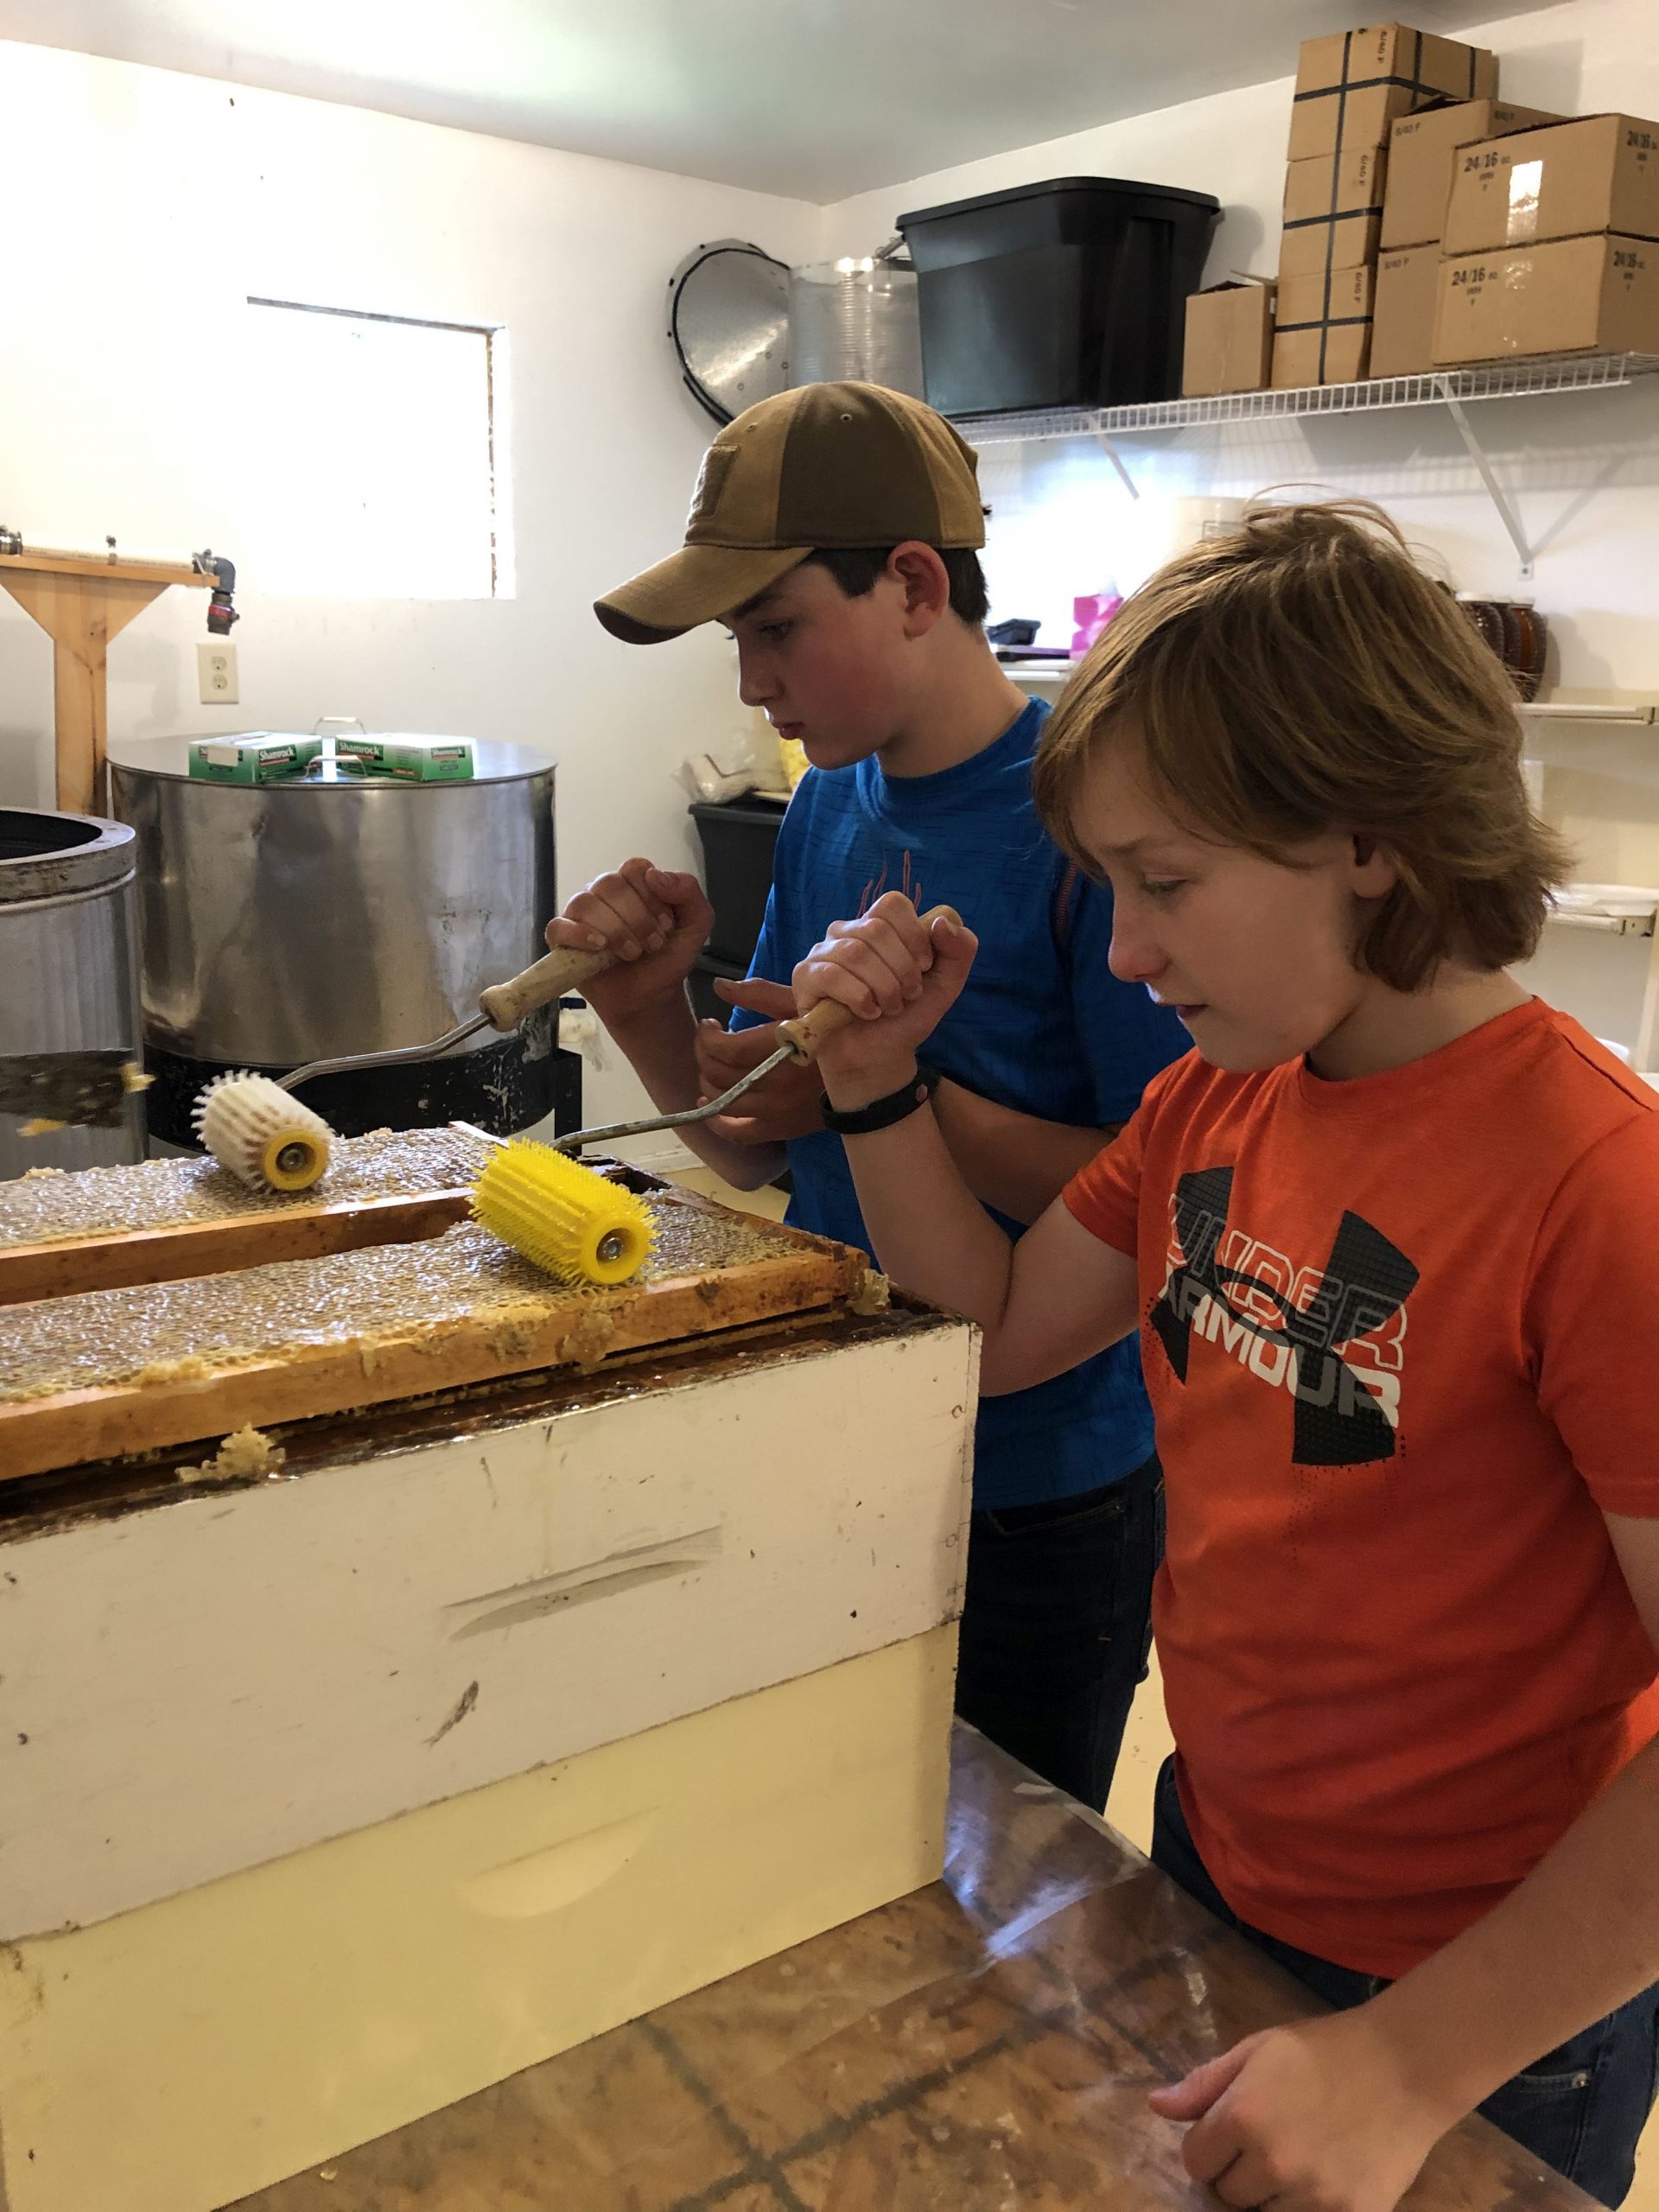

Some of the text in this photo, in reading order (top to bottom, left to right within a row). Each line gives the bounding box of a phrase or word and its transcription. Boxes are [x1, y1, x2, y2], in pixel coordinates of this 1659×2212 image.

[1452, 266, 1485, 286] 24/16
[259, 747, 295, 762] Shamrock
[338, 740, 380, 755] Shamrock
[1167, 1193, 1408, 1370] UNDER
[1157, 1262, 1402, 1429] ARMOUR
